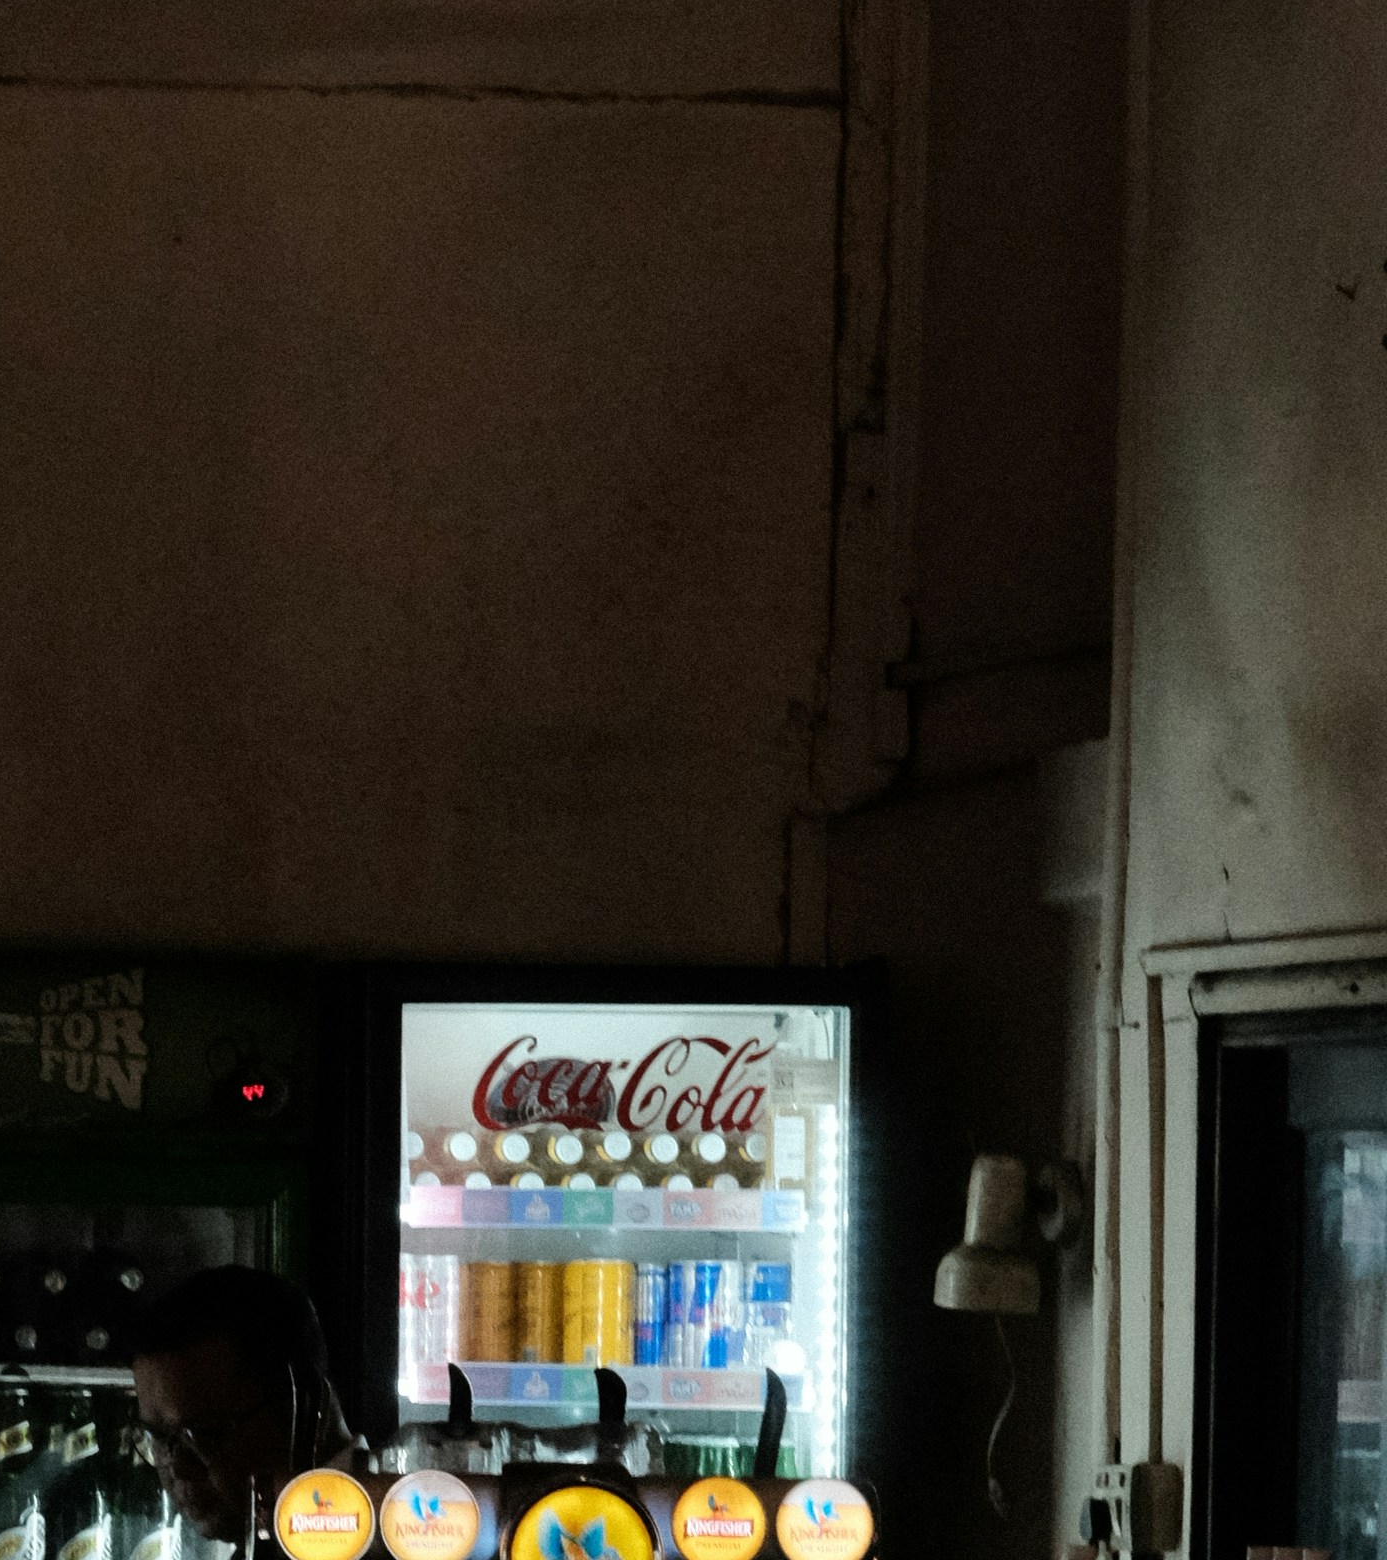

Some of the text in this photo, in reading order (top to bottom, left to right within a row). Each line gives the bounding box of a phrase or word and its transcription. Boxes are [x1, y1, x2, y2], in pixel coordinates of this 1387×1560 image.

[39, 968, 144, 1012] OPEN
[39, 1009, 148, 1056] FOR
[39, 1048, 148, 1110] FUN
[291, 1513, 359, 1533] KINGFISHER
[395, 1522, 465, 1539] KINGFISHER
[686, 1518, 754, 1538] KINGFISHER
[790, 1525, 860, 1543] KINGFISHER
